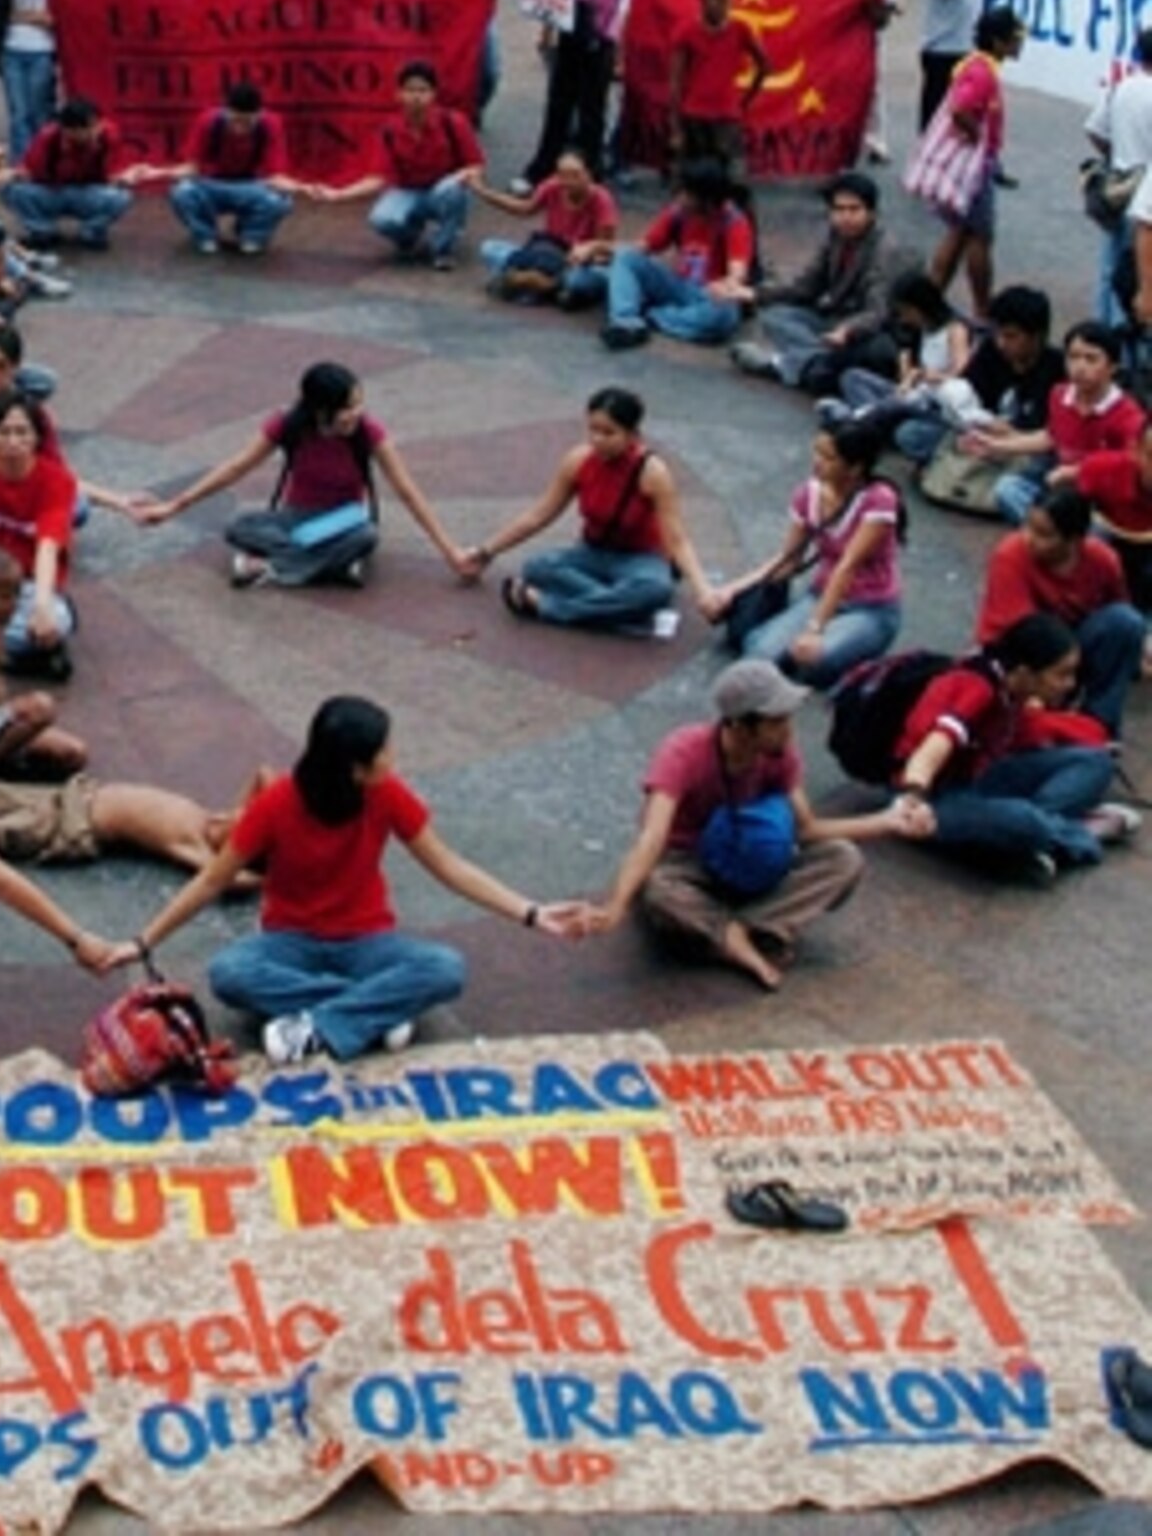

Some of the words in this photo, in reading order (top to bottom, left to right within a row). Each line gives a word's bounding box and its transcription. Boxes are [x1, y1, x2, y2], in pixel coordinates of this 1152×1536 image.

[648, 1054, 843, 1103] WALK
[846, 1042, 1028, 1092] OUT!
[280, 1132, 681, 1226] NOW!
[396, 1238, 629, 1357] dela
[137, 1364, 318, 1468] OUT
[352, 1372, 461, 1442] OF
[512, 1370, 763, 1441] IRAQ
[797, 1367, 1051, 1432] NOW
